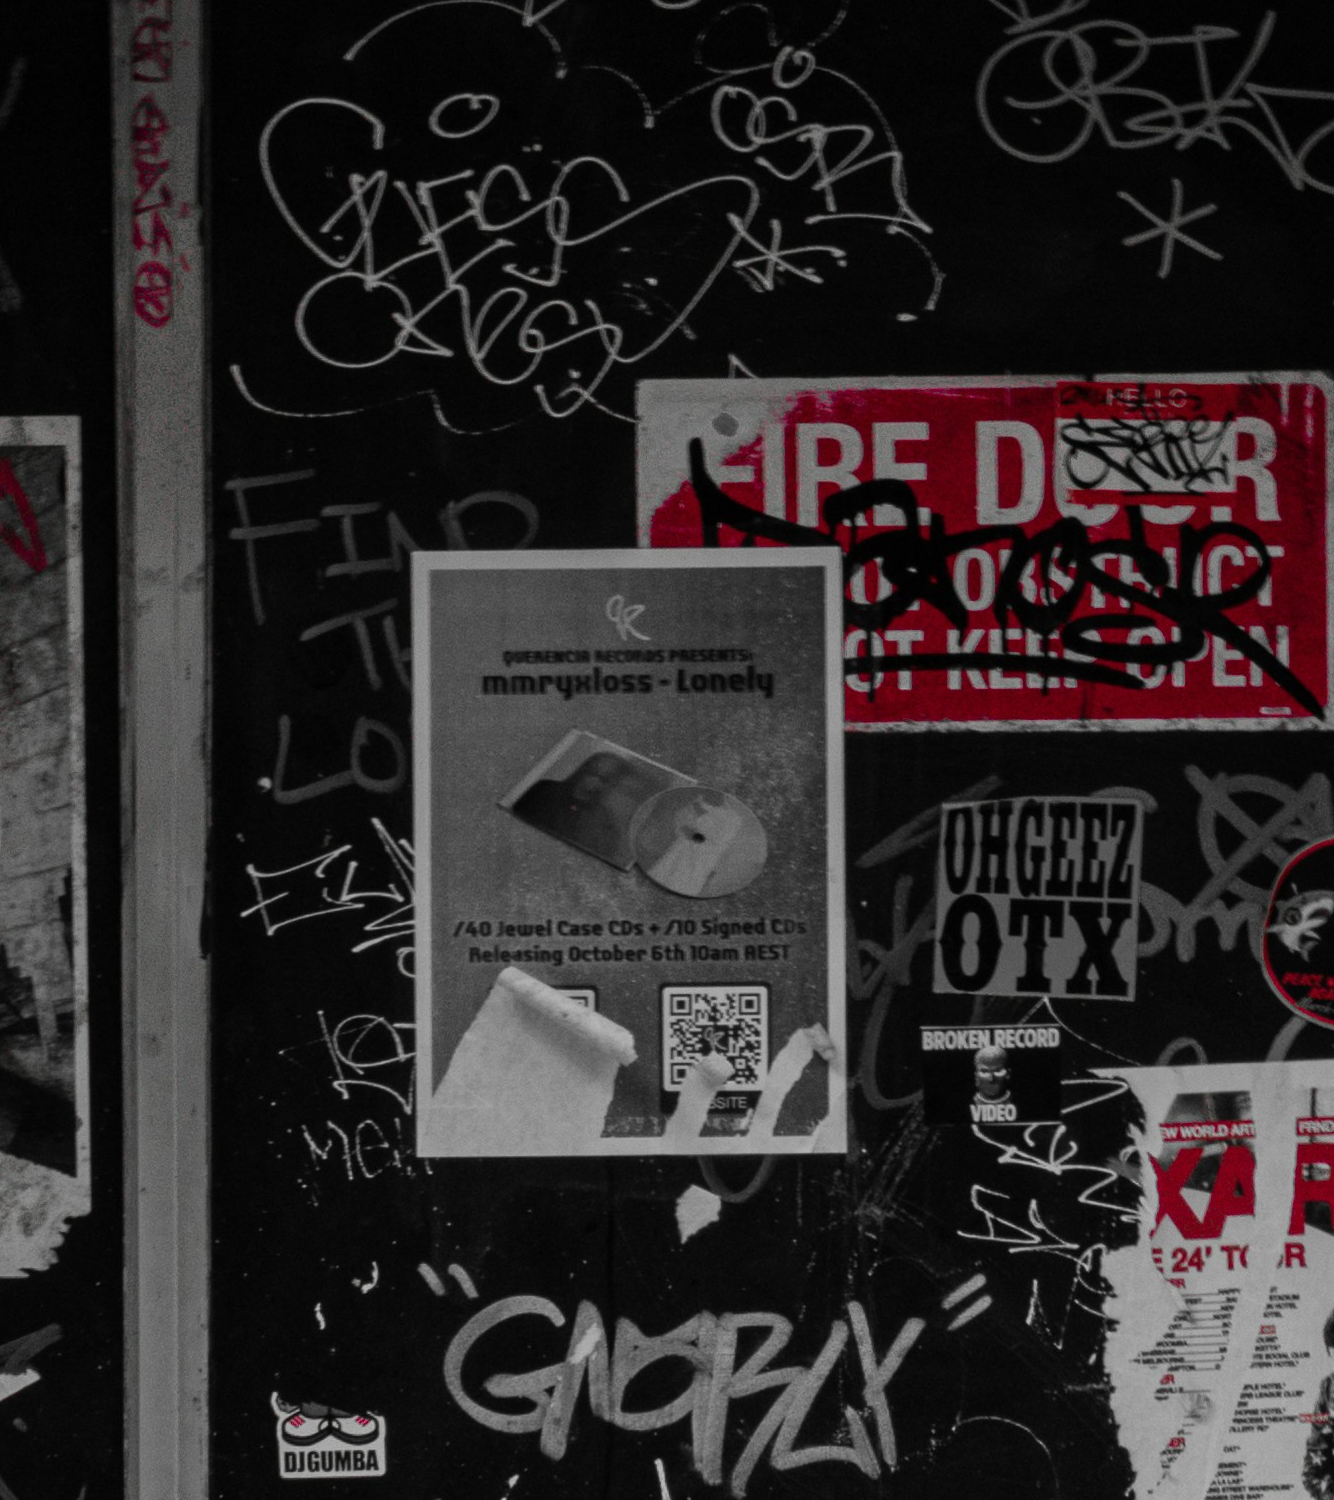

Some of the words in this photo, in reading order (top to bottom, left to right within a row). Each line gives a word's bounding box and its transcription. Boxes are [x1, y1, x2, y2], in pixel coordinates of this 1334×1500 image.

[975, 417, 1281, 527] DR
[594, 650, 665, 663] RECORDS
[845, 630, 923, 692] OT
[481, 665, 654, 701] mmryxloss
[676, 664, 775, 700] Lonely
[942, 800, 1134, 900] OHGEEZ
[497, 918, 552, 936] Jewel
[557, 919, 604, 937] Case
[608, 919, 645, 936] CDs
[701, 917, 766, 939] Signed
[771, 916, 808, 936] CDs
[468, 945, 564, 966] Releasing
[567, 944, 647, 963] October
[651, 944, 685, 962] 6th
[690, 943, 740, 962] 10am
[939, 894, 1130, 997] OTX
[921, 1029, 990, 1051] BROKEN
[994, 1027, 1061, 1049] RECORD
[969, 1103, 1017, 1123] VIDEO
[1180, 1123, 1229, 1138] WORLD
[1172, 1246, 1213, 1273] 24'
